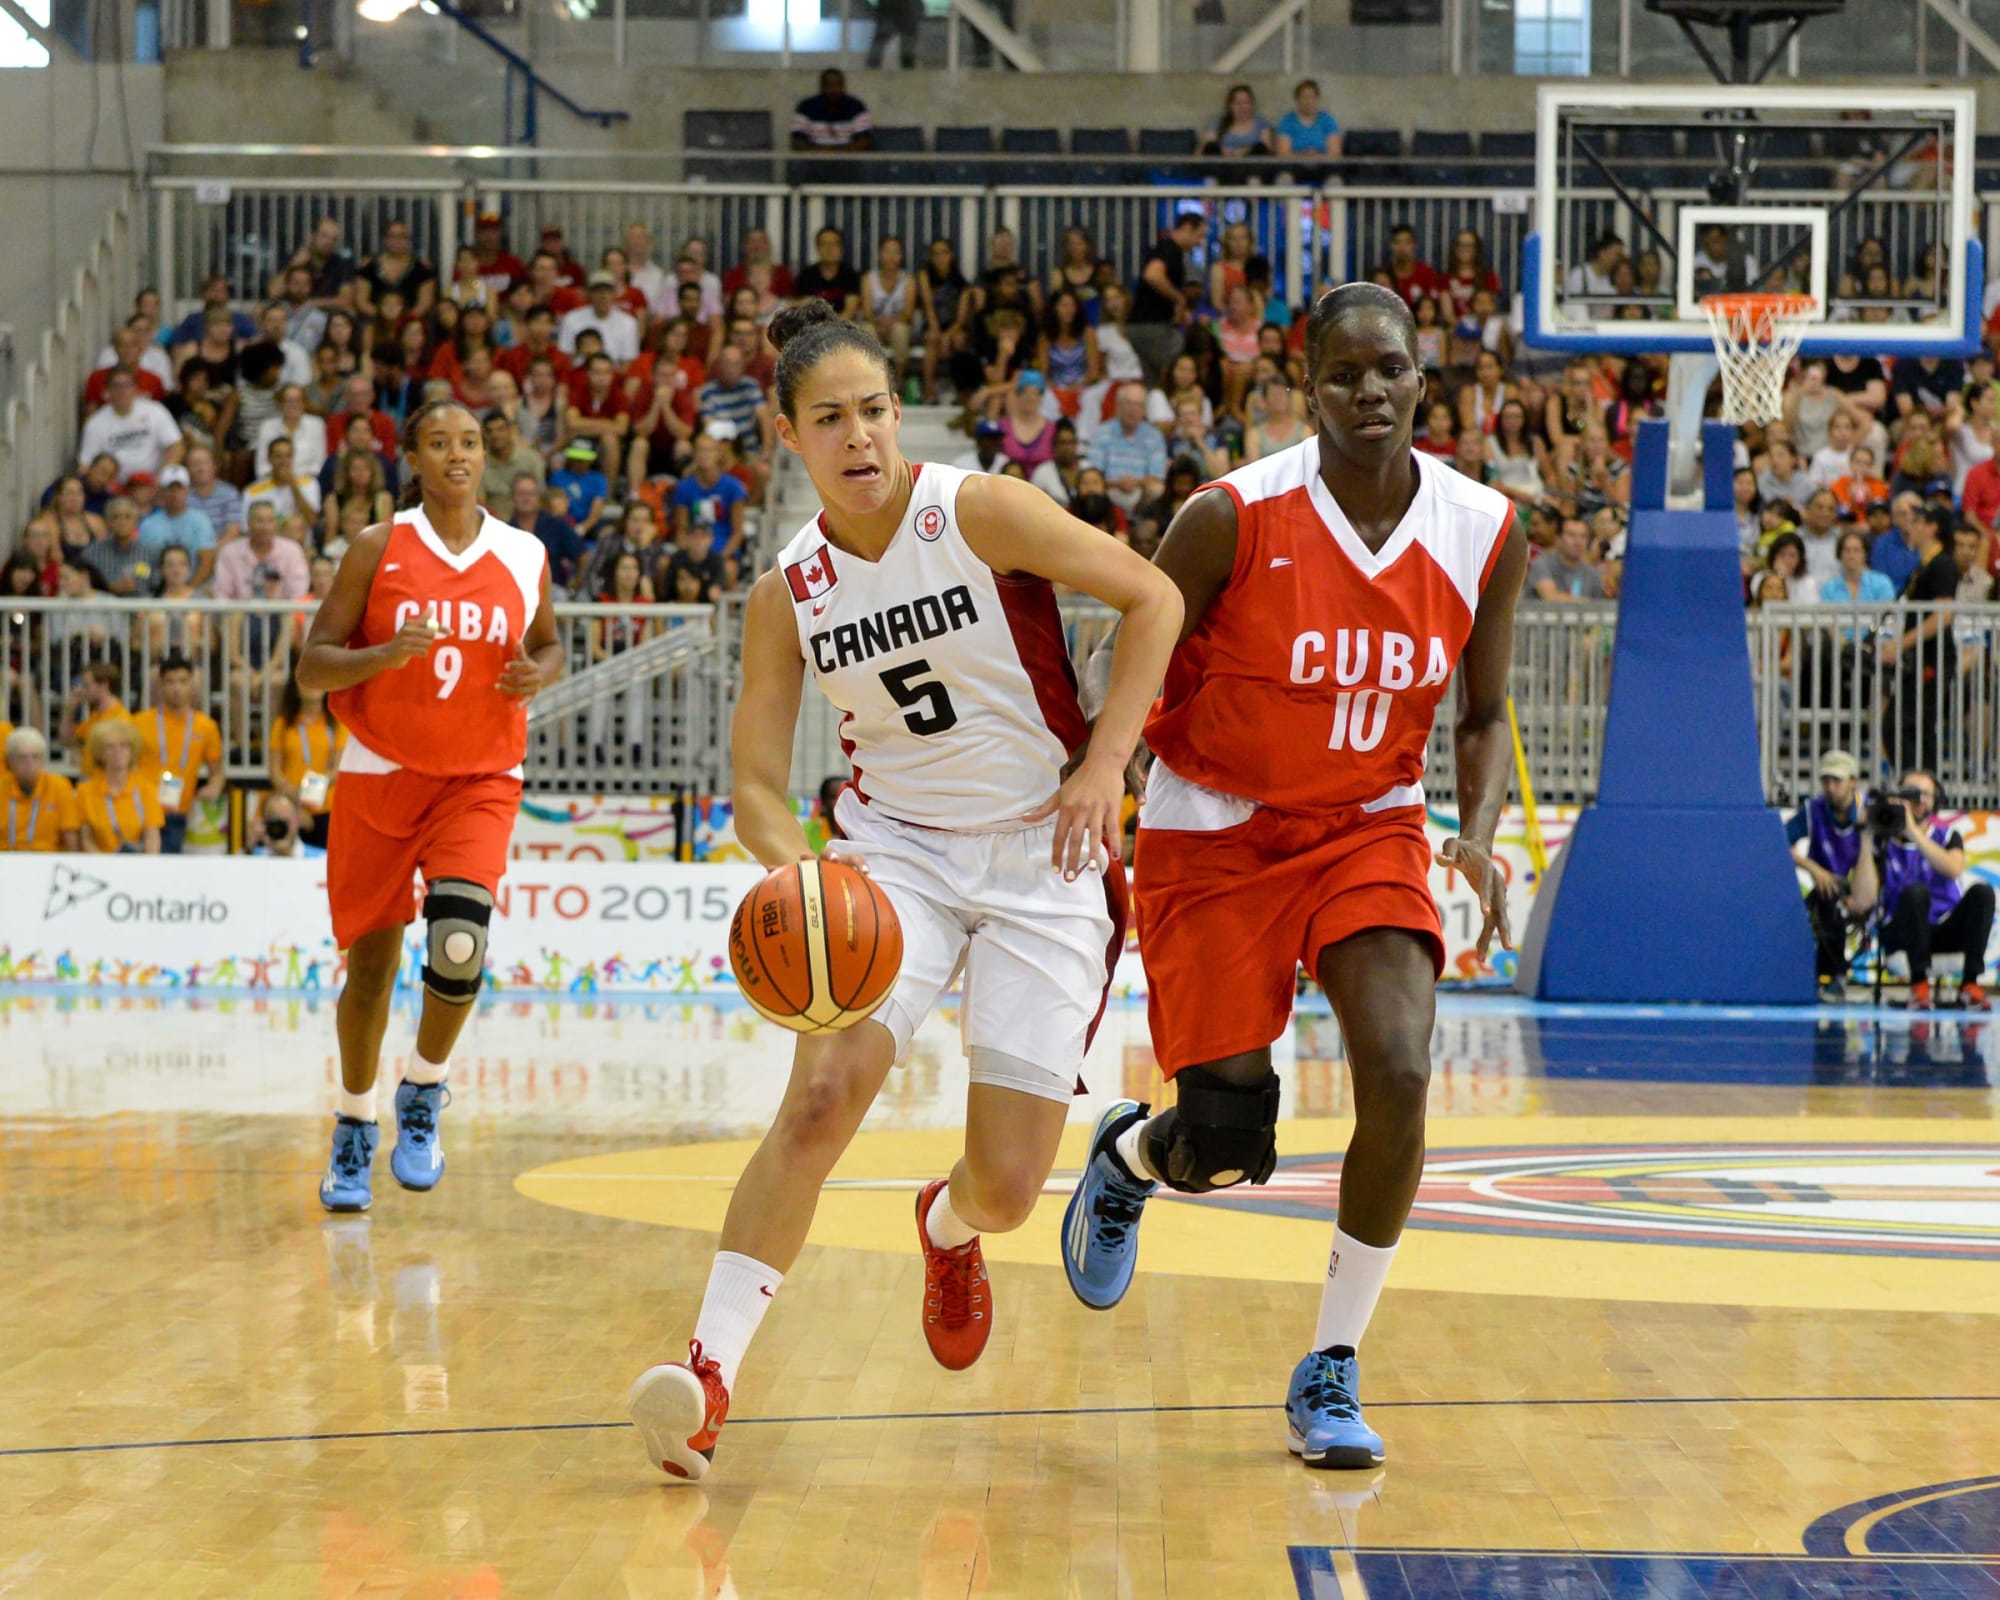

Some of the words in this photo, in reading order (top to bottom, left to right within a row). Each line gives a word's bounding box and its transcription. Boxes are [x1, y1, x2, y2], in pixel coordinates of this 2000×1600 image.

[395, 600, 508, 646] CUBA
[810, 585, 979, 674] CANADA
[434, 646, 463, 700] 9
[1289, 629, 1449, 691] CUBA
[879, 659, 958, 736] 5
[1328, 689, 1393, 752] 10
[107, 892, 228, 923] Ontario
[600, 885, 729, 920] 2015
[763, 901, 780, 937] FIBA
